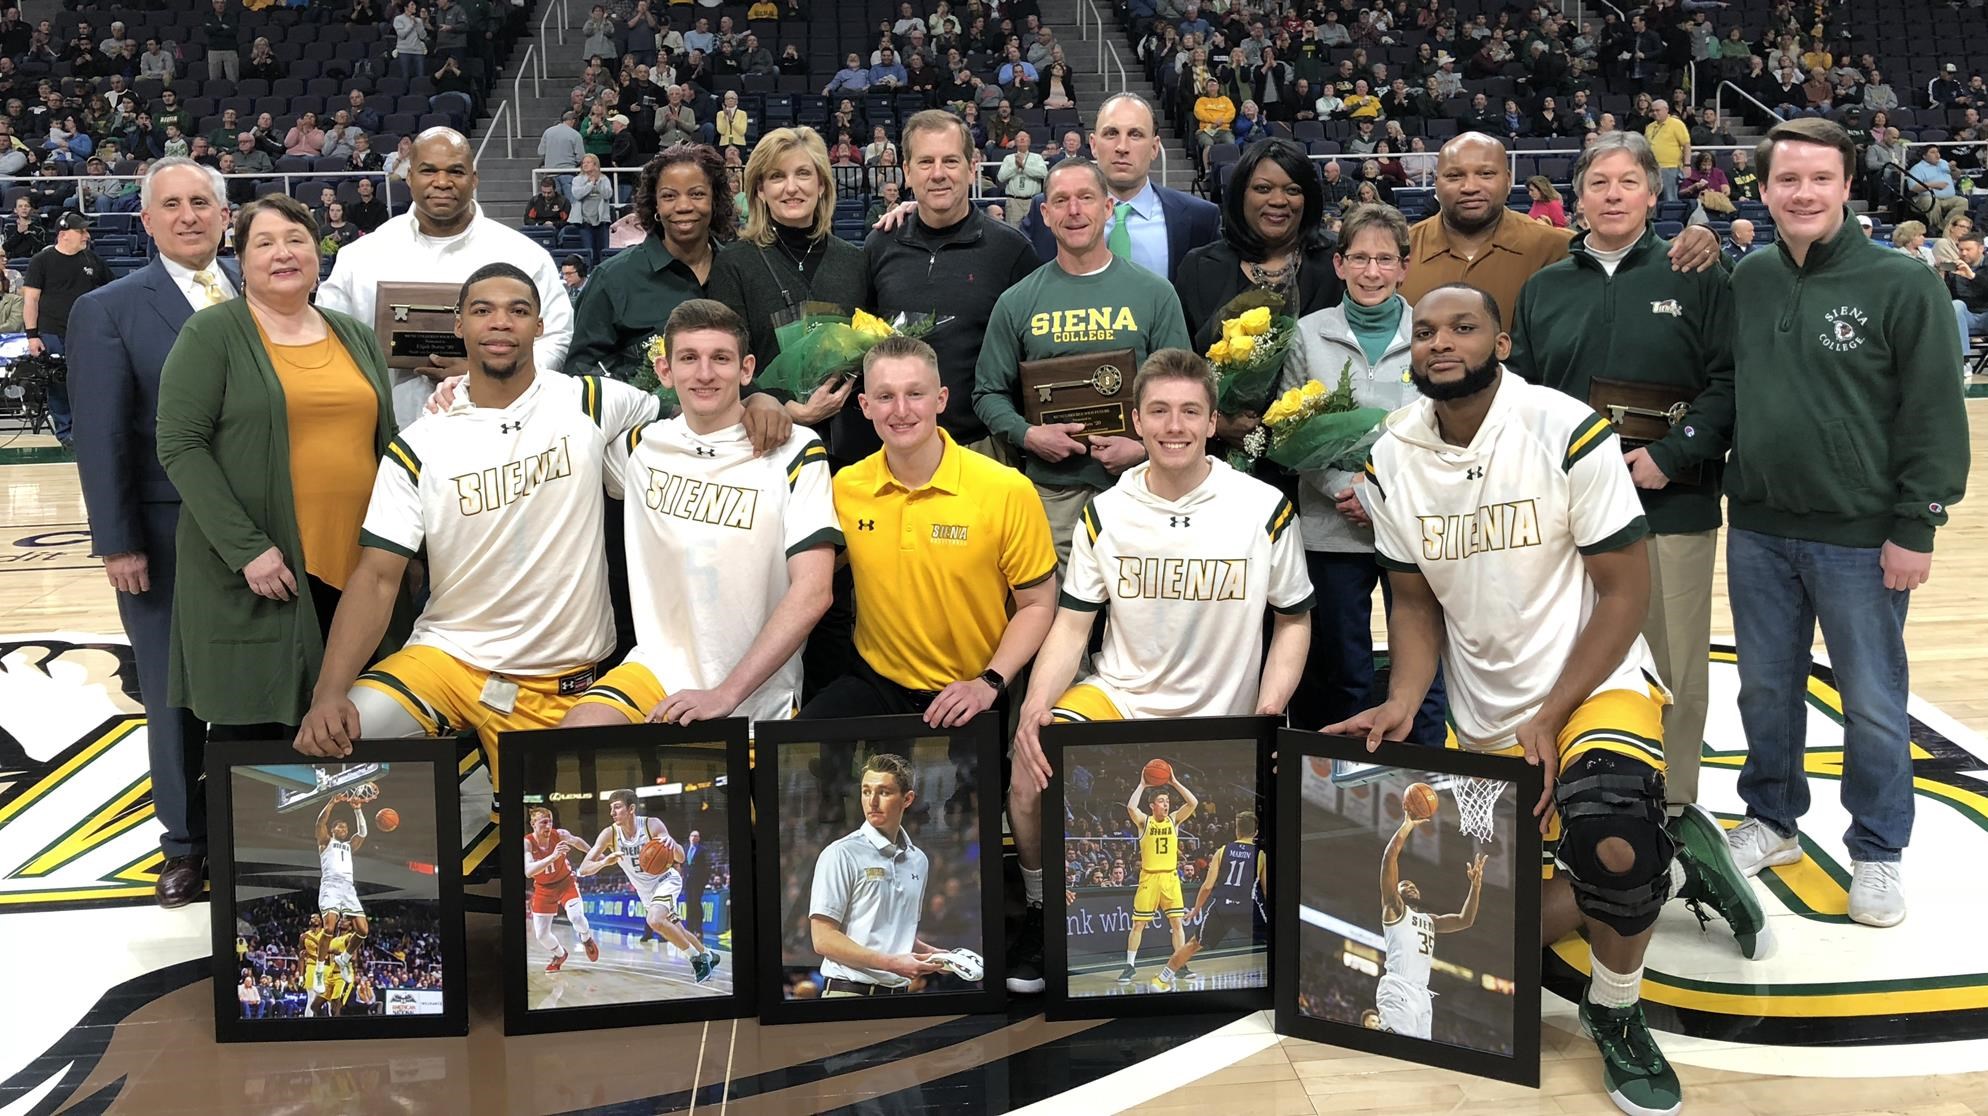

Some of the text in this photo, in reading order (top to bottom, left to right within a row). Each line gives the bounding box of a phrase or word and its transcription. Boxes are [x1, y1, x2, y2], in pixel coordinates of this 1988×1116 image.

[1031, 306, 1138, 336] SIENA
[1824, 306, 1869, 327] SIENA
[1053, 329, 1114, 343] COLLEGE
[1818, 333, 1864, 352] COLLEGE
[448, 436, 572, 516] SIENA
[645, 466, 759, 530] SIENA
[930, 523, 969, 541] SIENA
[1415, 498, 1542, 561] SIENA
[1112, 555, 1248, 601] SIENA
[1155, 837, 1169, 854] 13
[1224, 860, 1245, 887] 11
